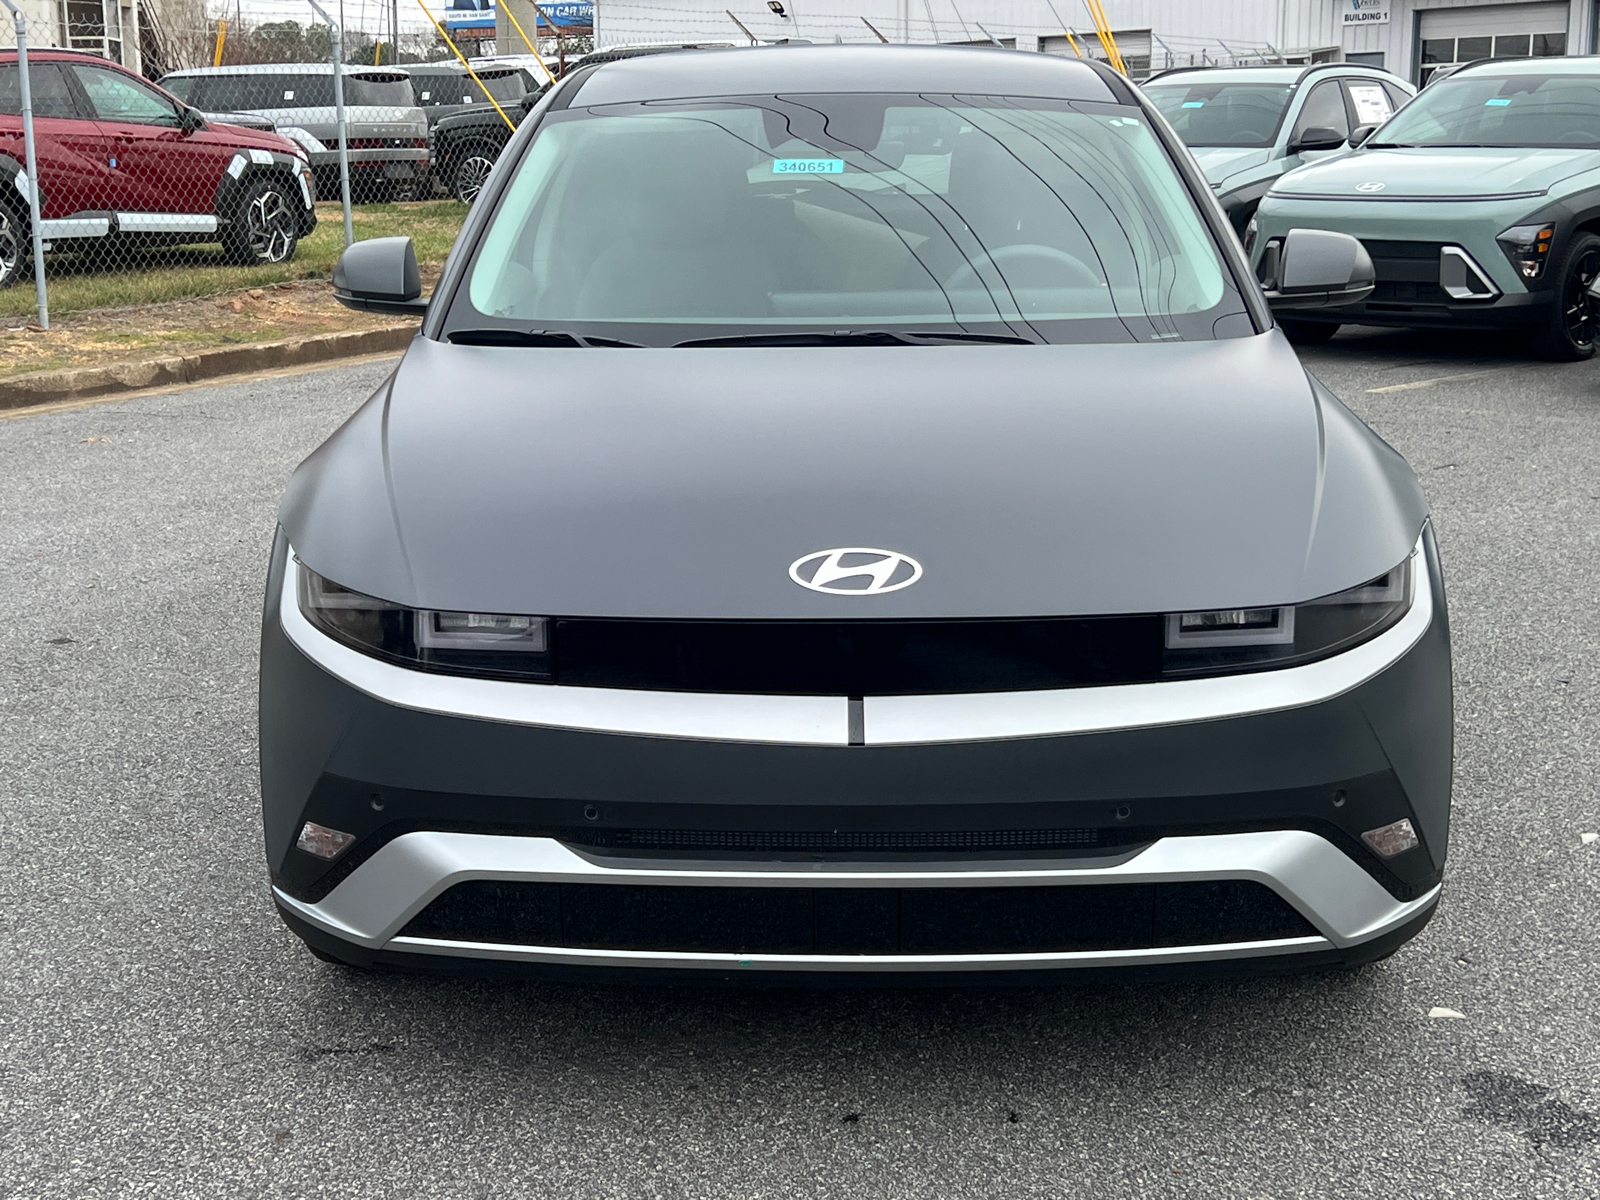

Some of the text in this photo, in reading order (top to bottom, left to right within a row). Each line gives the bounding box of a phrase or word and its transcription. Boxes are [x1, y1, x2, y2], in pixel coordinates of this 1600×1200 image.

[556, 6, 578, 17] CAR
[1344, 12, 1388, 22] BUILDING 1
[779, 162, 834, 172] 340651
